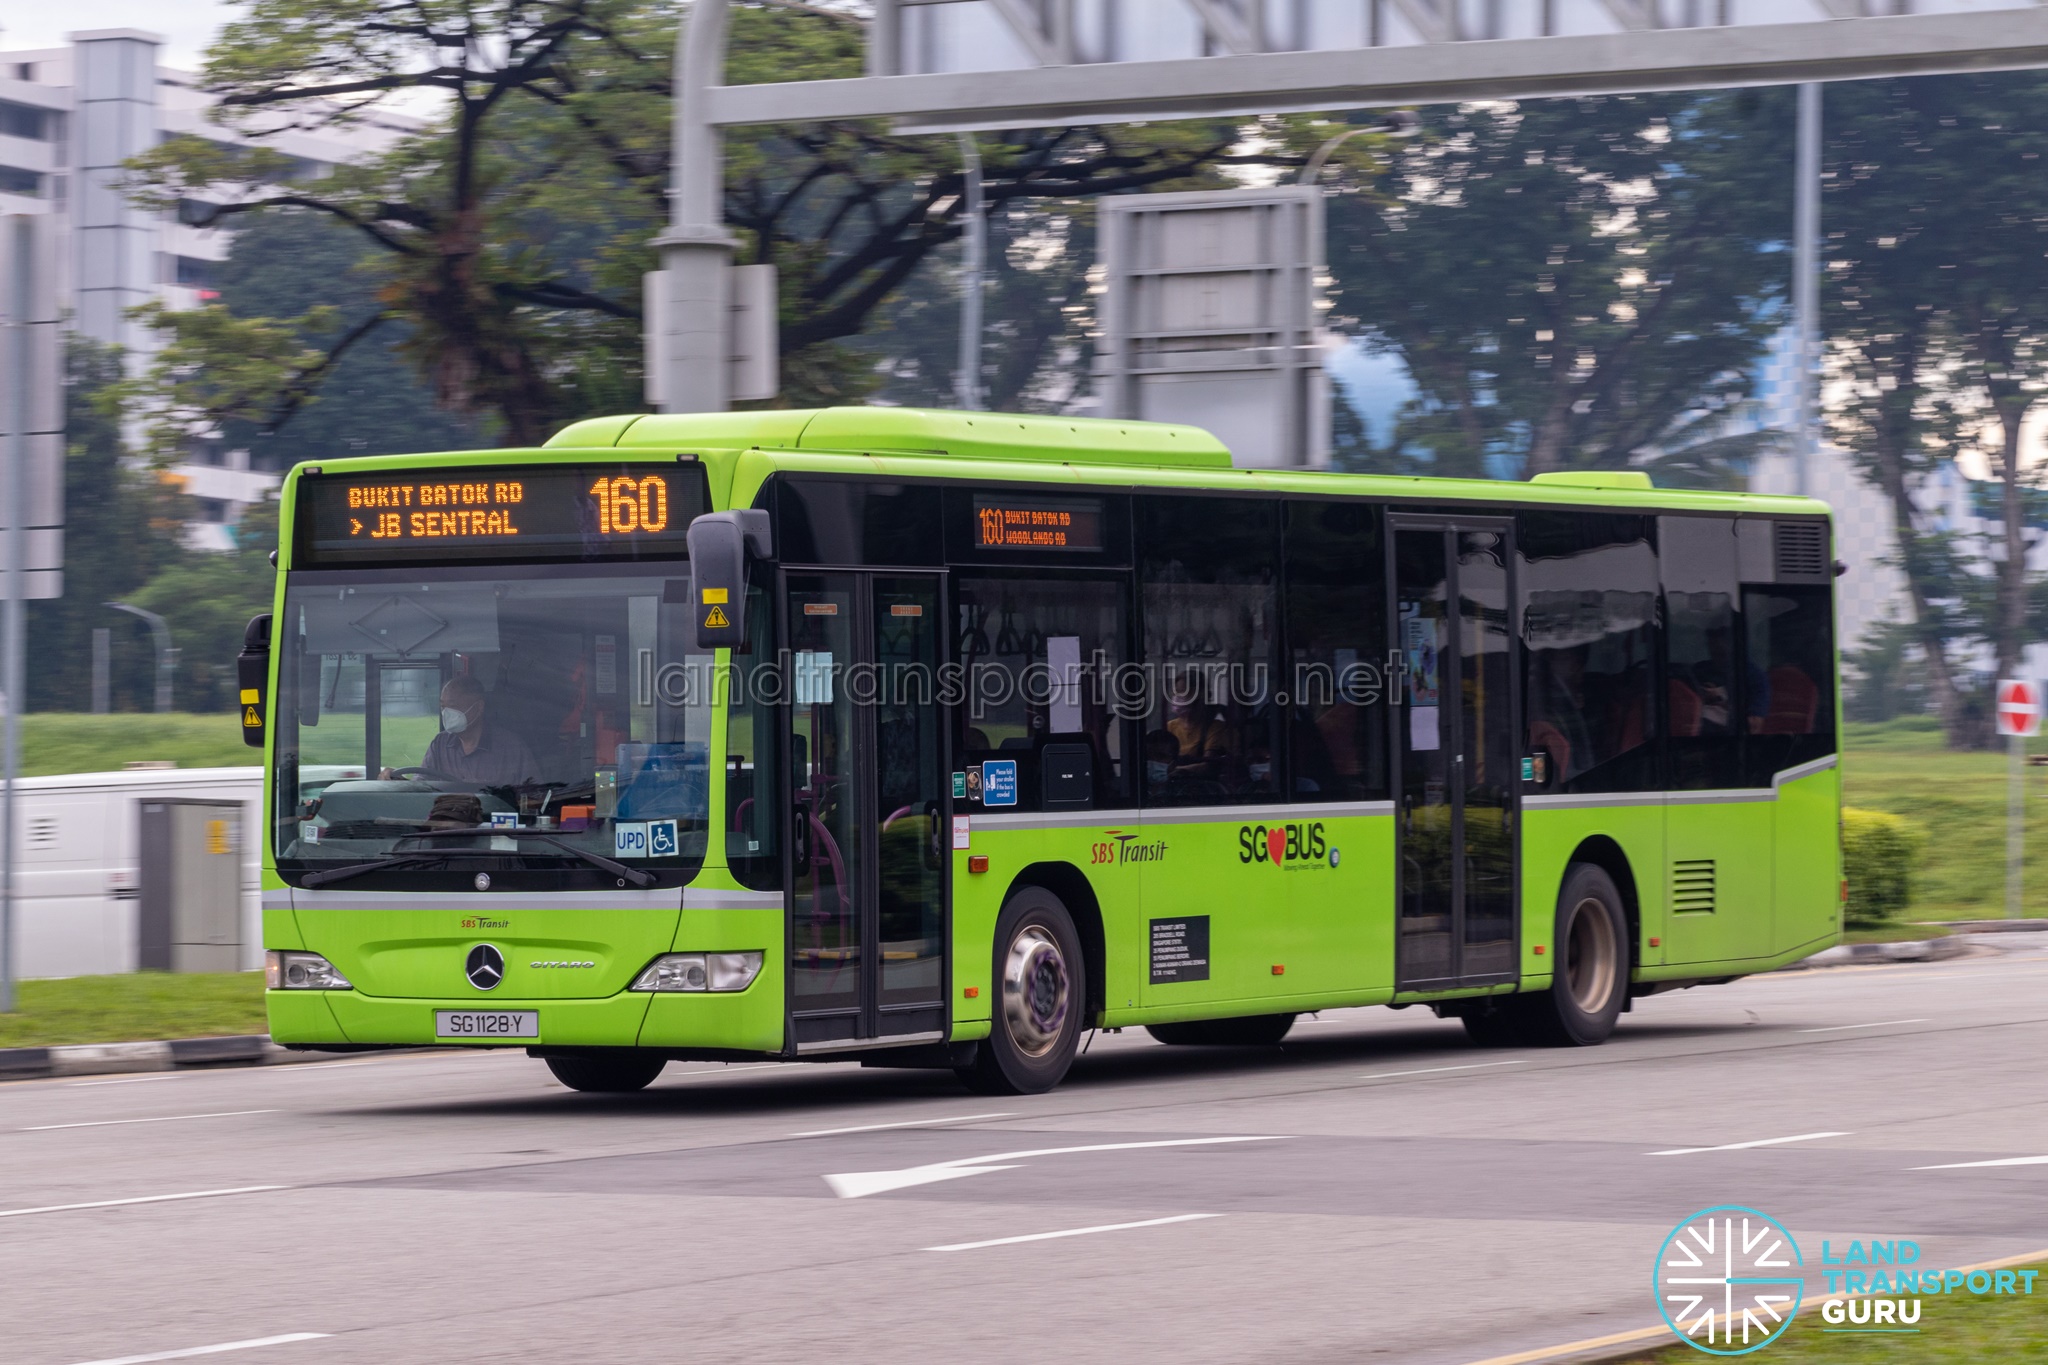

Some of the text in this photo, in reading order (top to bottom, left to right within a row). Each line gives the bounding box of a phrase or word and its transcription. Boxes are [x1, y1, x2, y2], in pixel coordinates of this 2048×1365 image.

[349, 482, 522, 508] BUKIT BATOK RD
[590, 475, 668, 534] 160
[371, 512, 401, 538] JB
[411, 510, 518, 537] SENTRAL
[979, 508, 1004, 545] 160
[1005, 510, 1030, 524] BUKIT
[1032, 511, 1058, 526] BATOK
[617, 831, 645, 849] UPD
[1091, 834, 1169, 867] SBS Transit
[1239, 822, 1325, 863] SG BUS
[461, 917, 510, 929] SBS Transit
[530, 961, 595, 969] CITARO
[450, 1015, 523, 1033] SG1128Y
